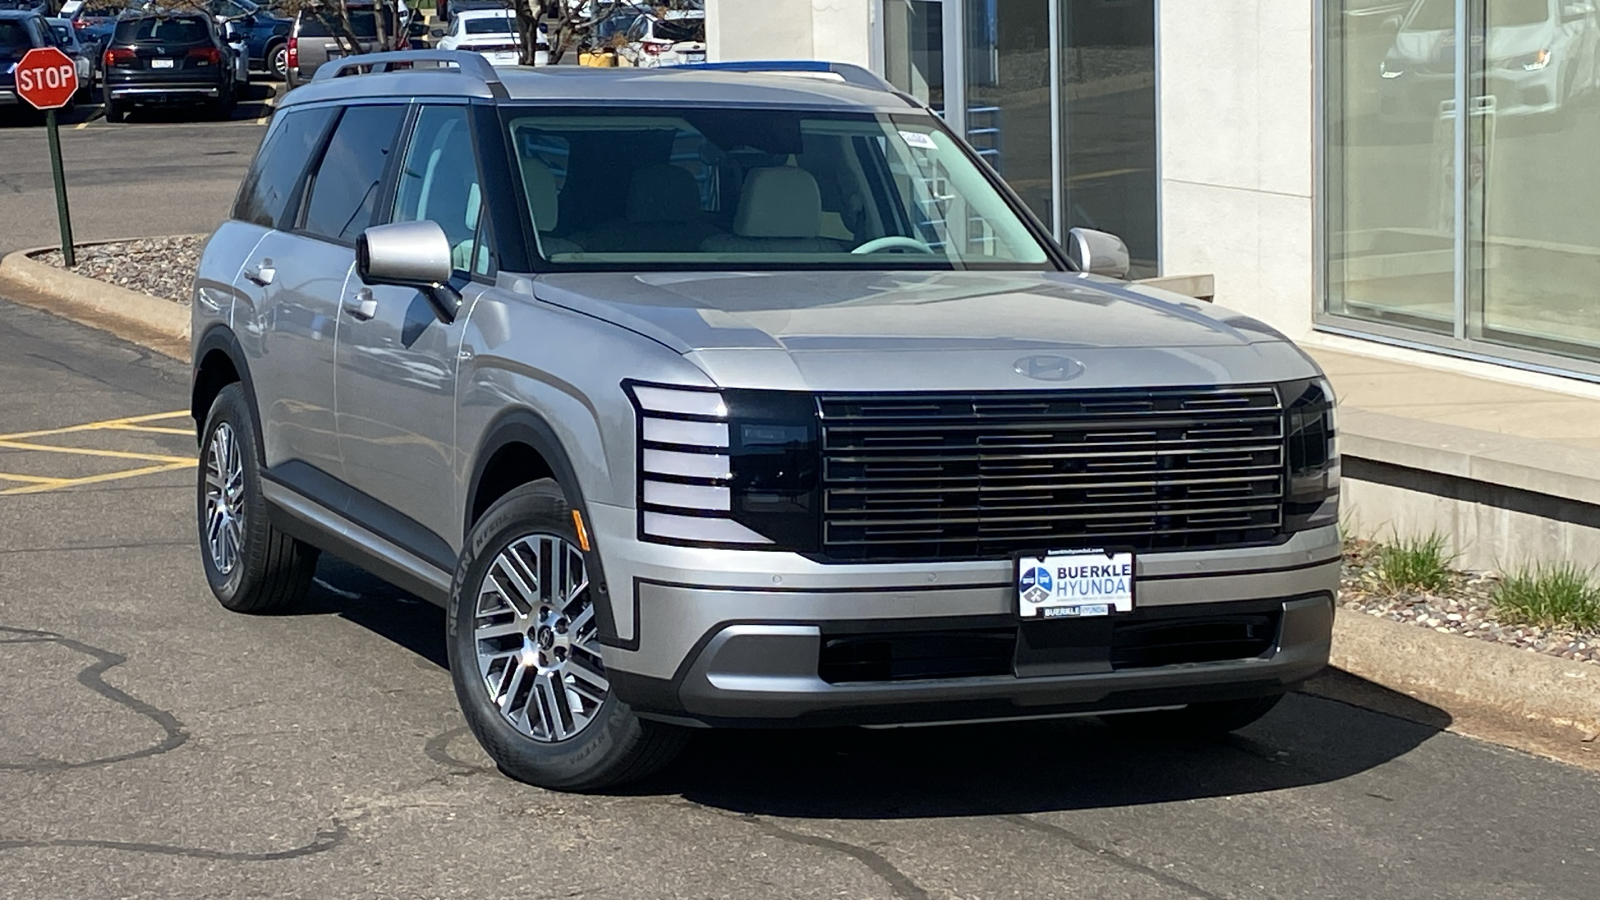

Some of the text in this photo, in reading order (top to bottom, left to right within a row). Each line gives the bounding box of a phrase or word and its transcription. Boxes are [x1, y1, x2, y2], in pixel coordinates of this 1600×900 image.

[20, 64, 73, 91] STOP
[1057, 564, 1131, 579] BUERKLE
[449, 552, 474, 638] NEXEN
[1057, 578, 1132, 597] HYUNDAI
